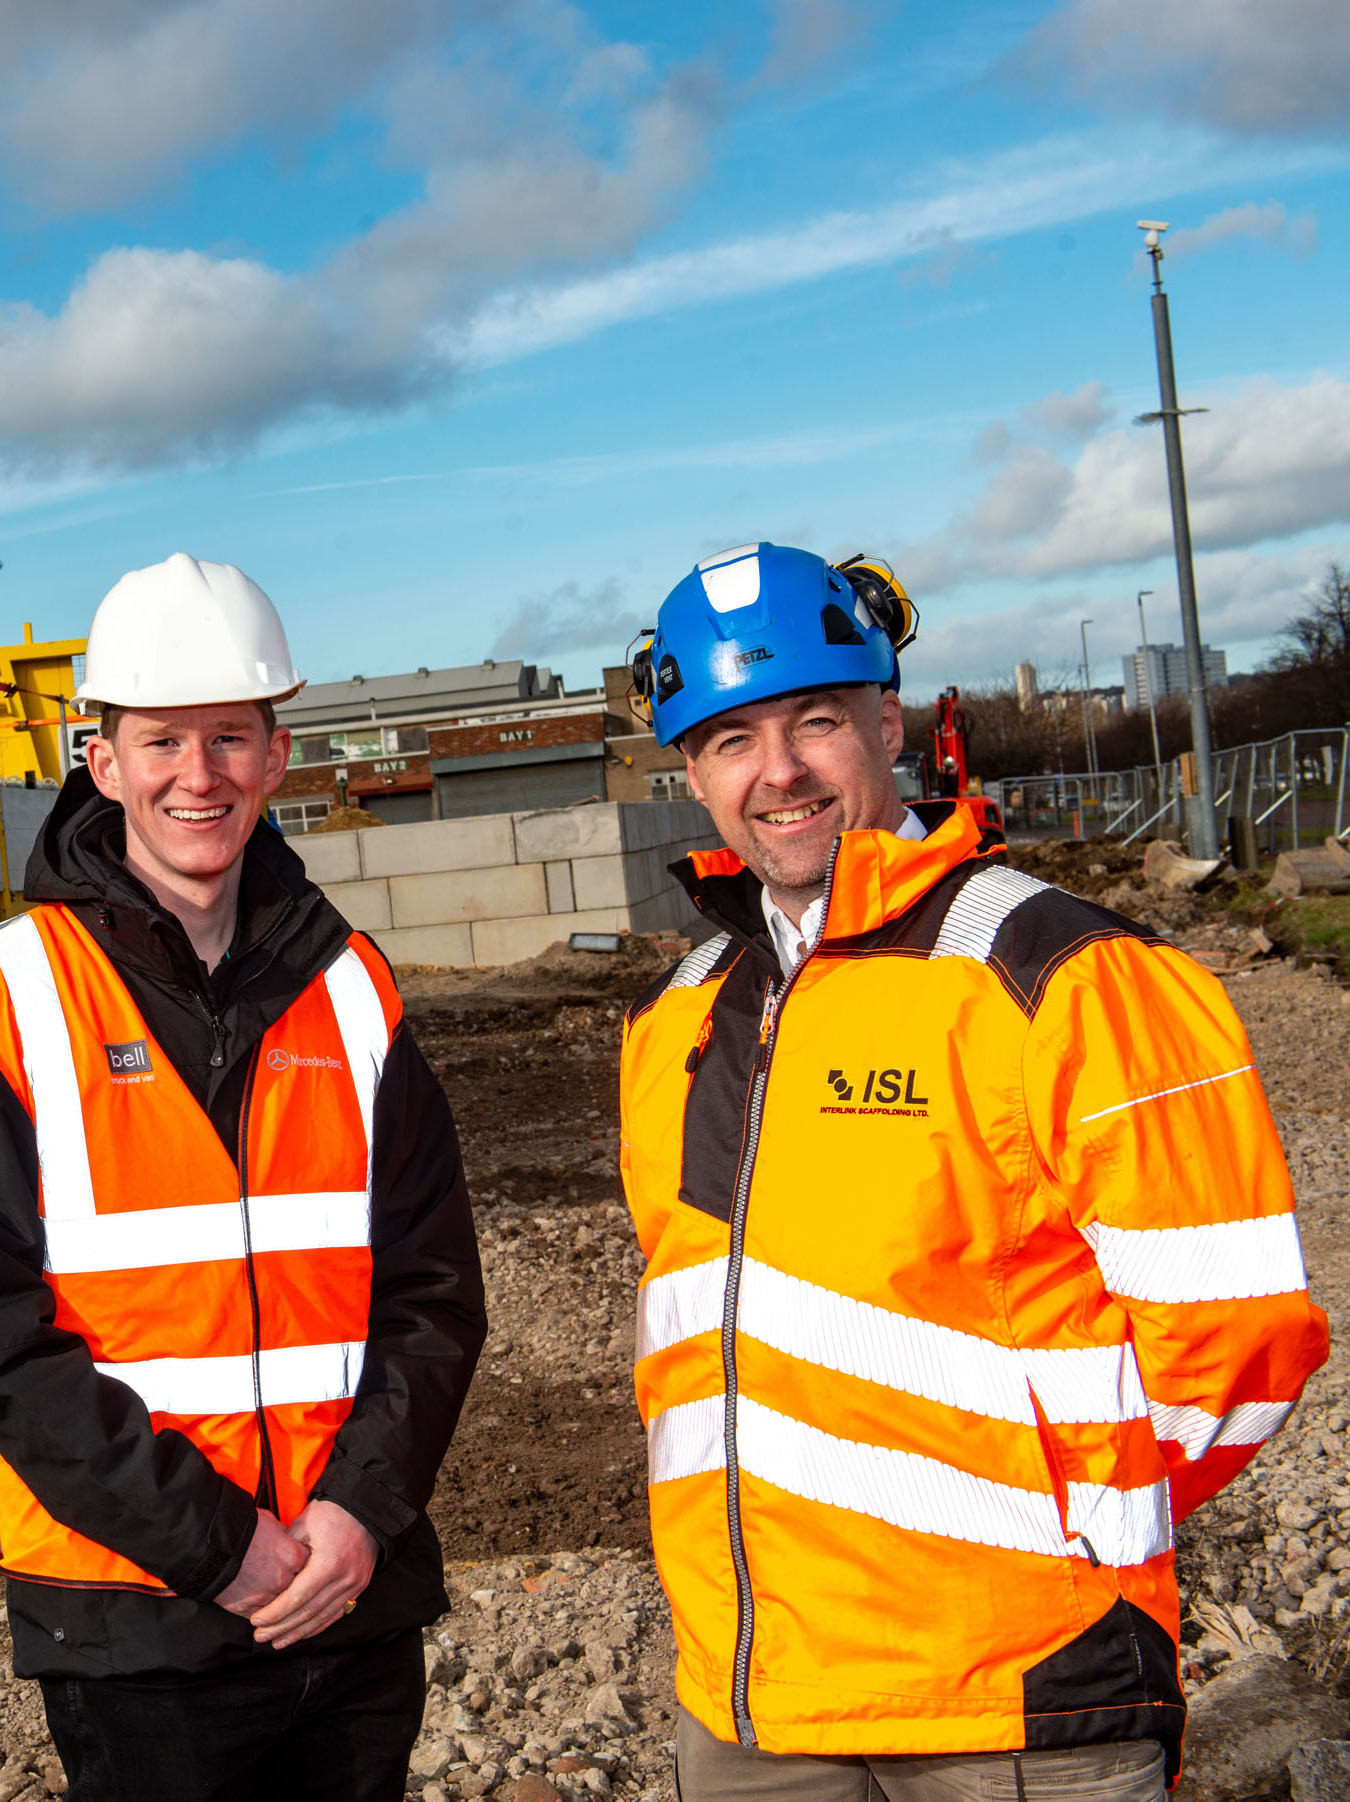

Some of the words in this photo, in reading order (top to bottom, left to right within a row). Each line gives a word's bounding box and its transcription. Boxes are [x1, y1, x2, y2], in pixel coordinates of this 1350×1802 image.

[734, 648, 774, 672] PETZL
[500, 730, 523, 742] BAY
[374, 761, 397, 773] BAY
[110, 1046, 145, 1068] bell
[290, 1054, 343, 1070] Mercedes-Benz
[127, 1075, 140, 1083] and
[142, 1074, 155, 1082] van
[862, 1069, 929, 1105] ISL
[820, 1106, 857, 1115] INTERLINK
[858, 1107, 912, 1117] SCAFFOLDING
